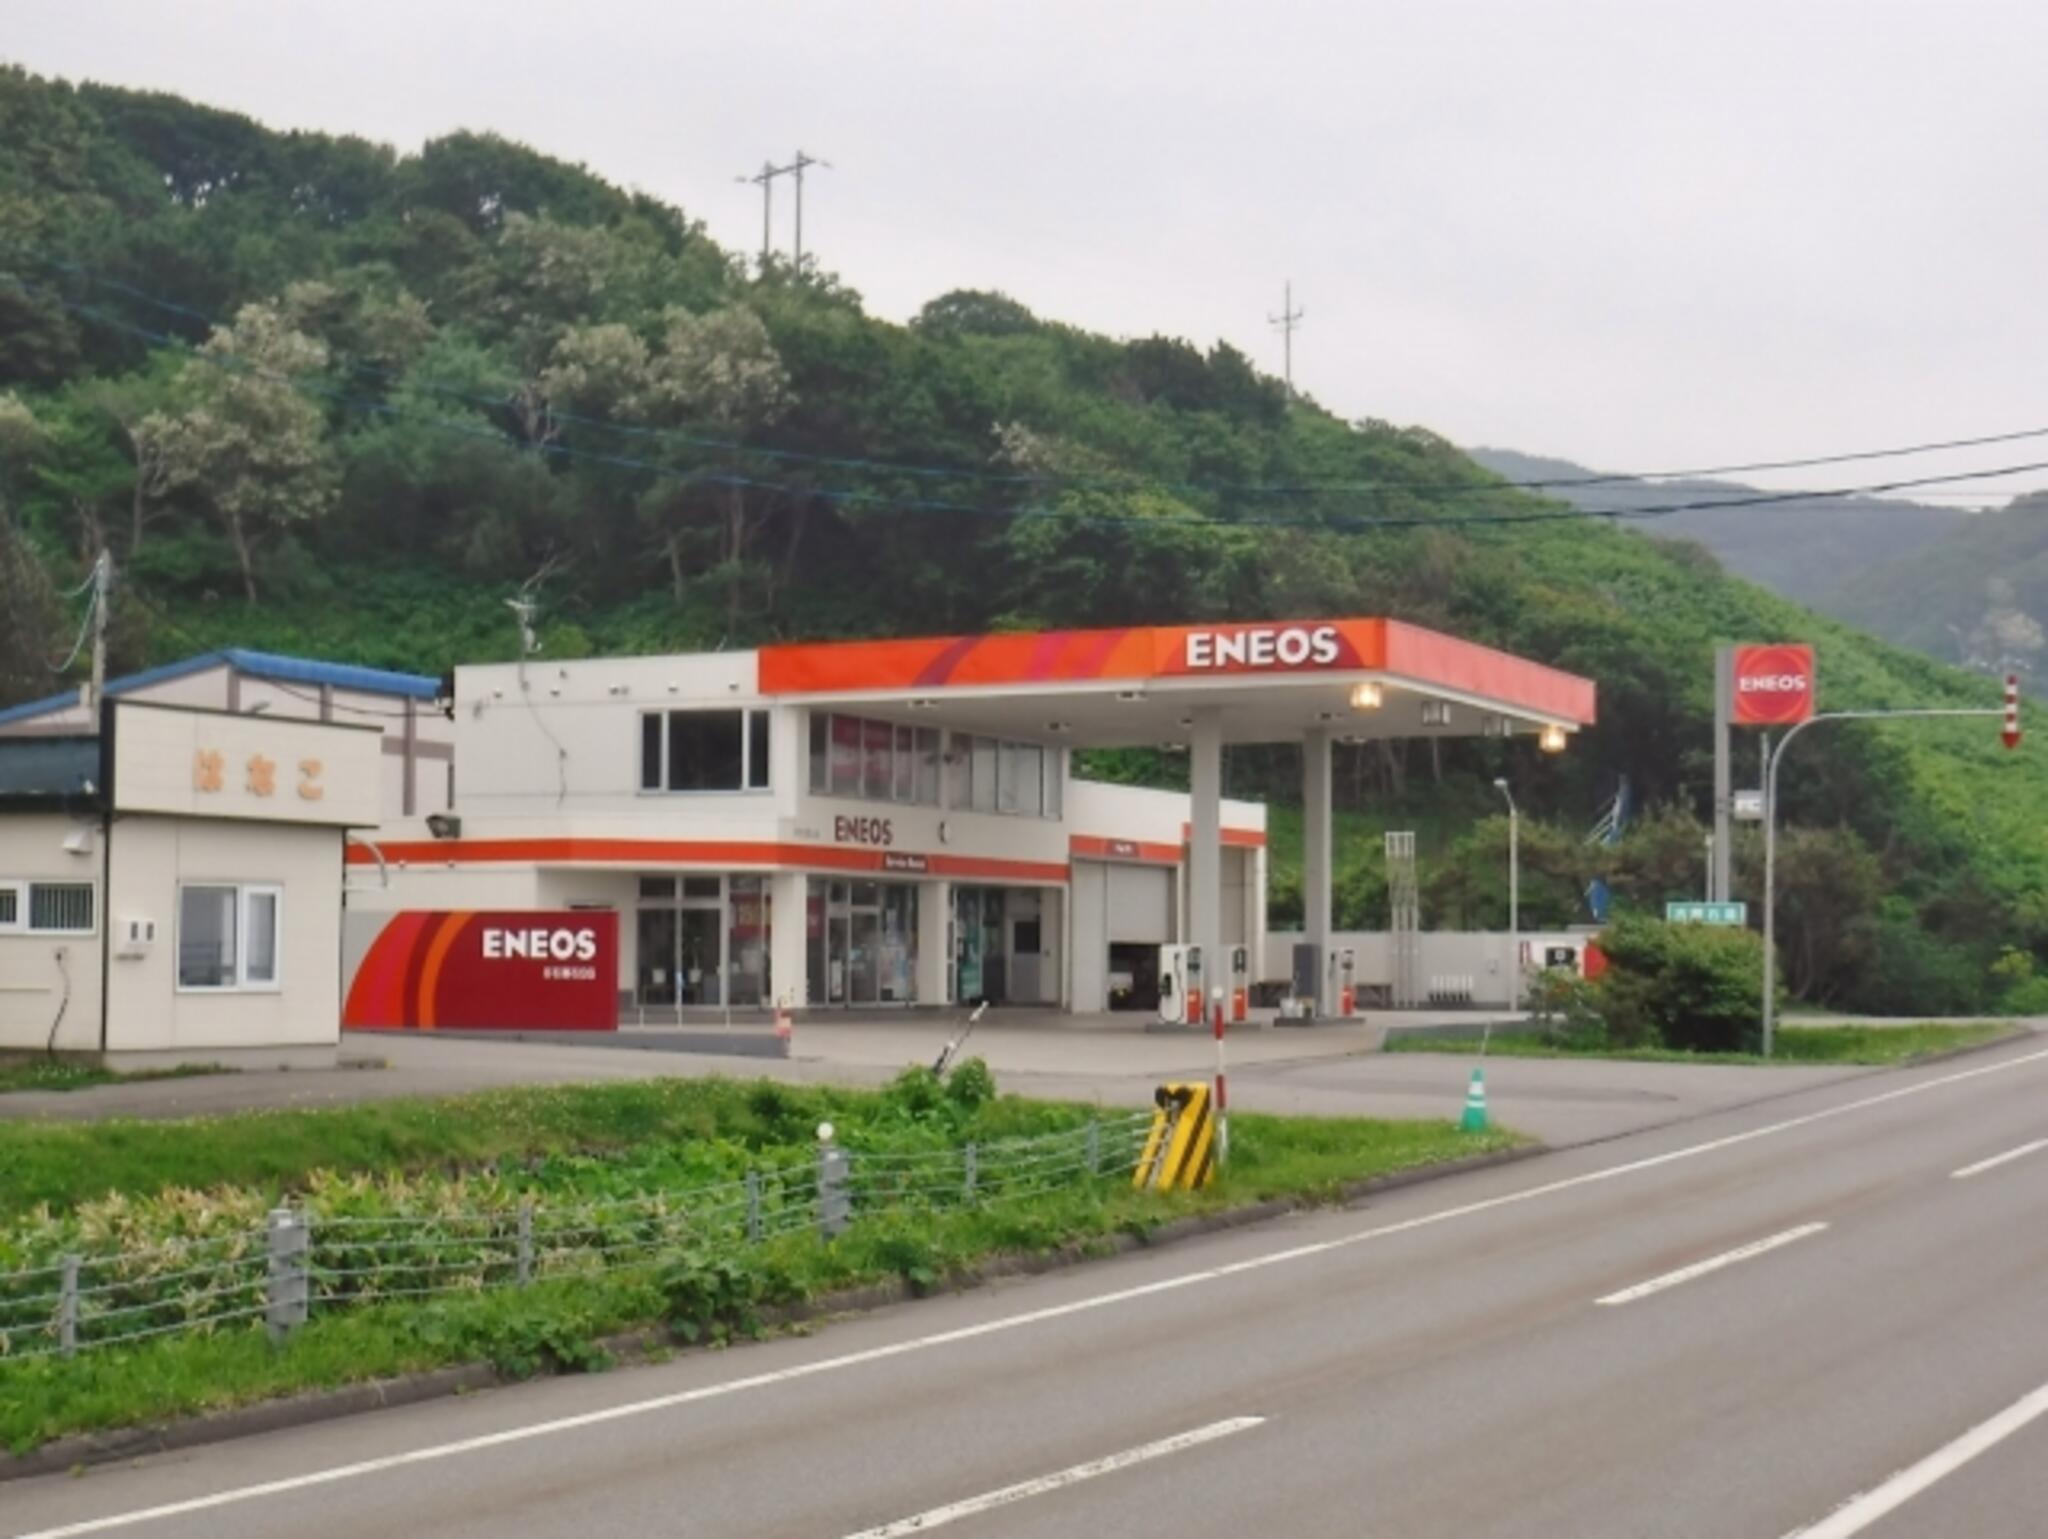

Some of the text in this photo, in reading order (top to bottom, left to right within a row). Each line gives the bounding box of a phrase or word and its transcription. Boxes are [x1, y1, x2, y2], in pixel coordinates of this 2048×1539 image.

[1186, 626, 1339, 667] ENEOS
[1739, 674, 1806, 692] ENEOS
[835, 815, 892, 845] ENEOS
[482, 928, 597, 960] ENEOS
